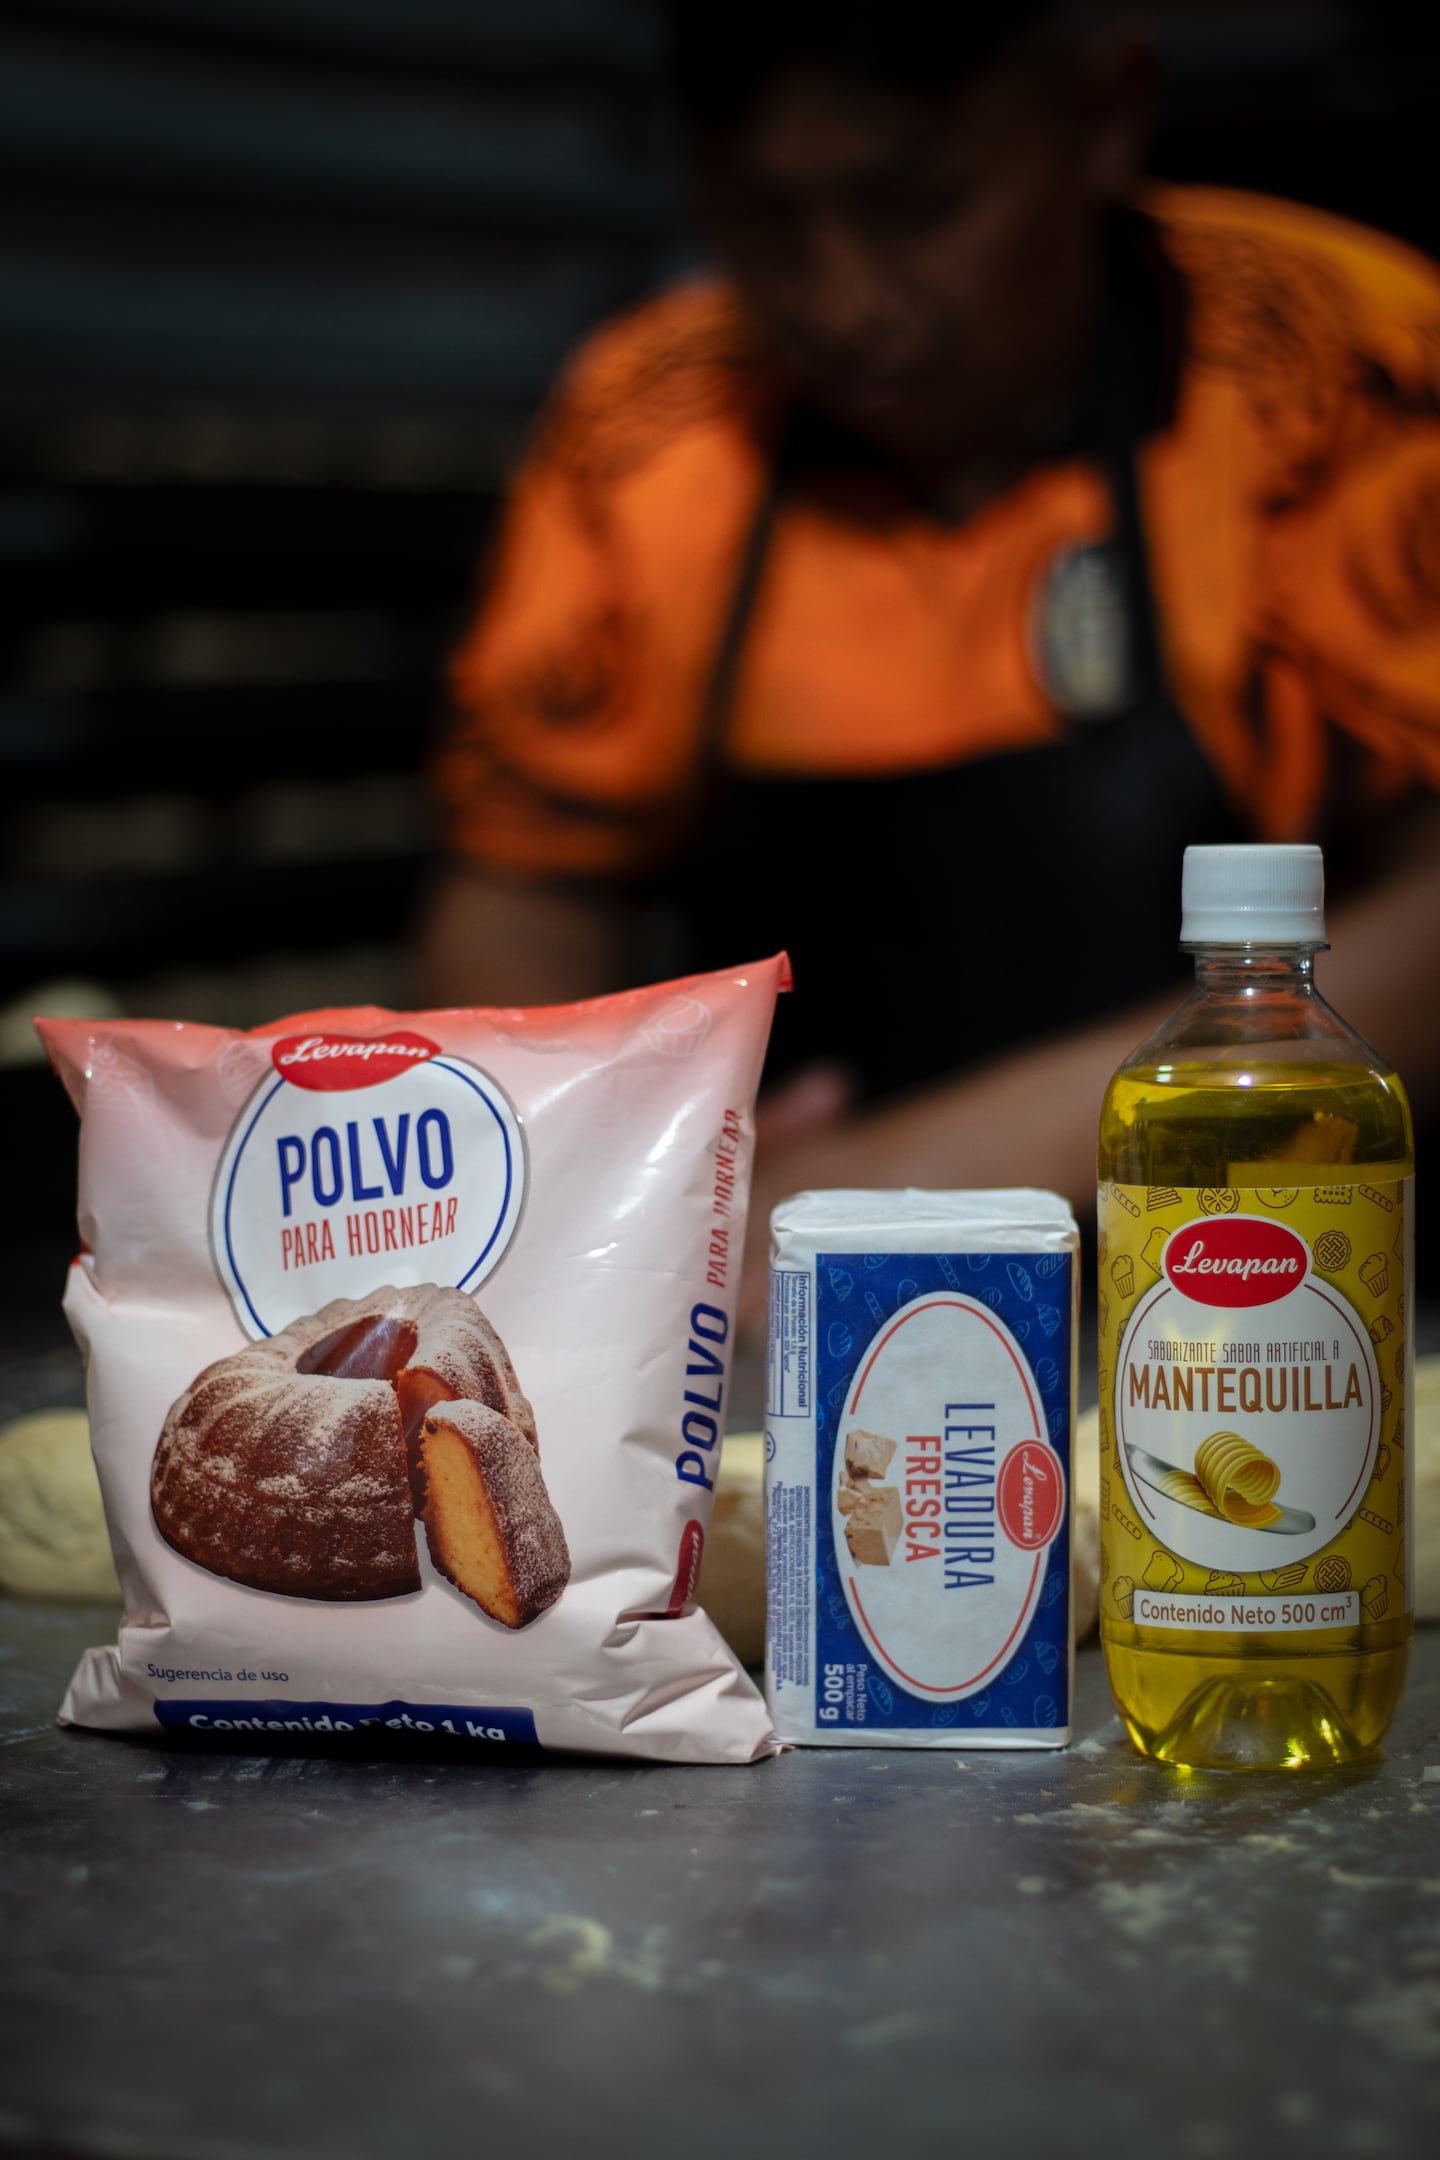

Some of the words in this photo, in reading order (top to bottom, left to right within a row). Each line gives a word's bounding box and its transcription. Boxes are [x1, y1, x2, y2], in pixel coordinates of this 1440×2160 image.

[280, 1037, 431, 1066] Levapan
[277, 1108, 454, 1218] POLVO
[281, 1219, 336, 1271] PARA
[346, 1197, 458, 1257] HORNEAR
[1172, 1240, 1298, 1281] Levapan
[798, 1275, 808, 1342] Información
[675, 1303, 729, 1492] POLVO
[706, 1228, 730, 1288] PARA
[1148, 1340, 1216, 1363] SABORIZANTE
[1223, 1343, 1260, 1363] SABOR
[1266, 1341, 1327, 1363] ARTIFICIAL
[1333, 1340, 1339, 1360] A
[798, 1346, 808, 1407] Nutricional
[1129, 1362, 1363, 1413] MANTEQUILLA
[905, 1436, 941, 1562] FRESCA
[944, 1404, 995, 1589] LEVADURA
[1019, 1451, 1047, 1539] Levapan
[1140, 1599, 1225, 1624] Contenido
[1231, 1605, 1276, 1625] Neto
[1281, 1603, 1315, 1623] 500
[147, 1664, 233, 1682] Sugerencia
[236, 1669, 257, 1681] de
[261, 1671, 289, 1682] uso
[824, 1664, 844, 1703] 500
[846, 1664, 856, 1674] al
[856, 1664, 868, 1691] Peso
[819, 1706, 839, 1720] g
[845, 1675, 855, 1720] empacar
[856, 1693, 868, 1721] Neto
[188, 1714, 355, 1733] Contenido
[441, 1719, 461, 1735] 1
